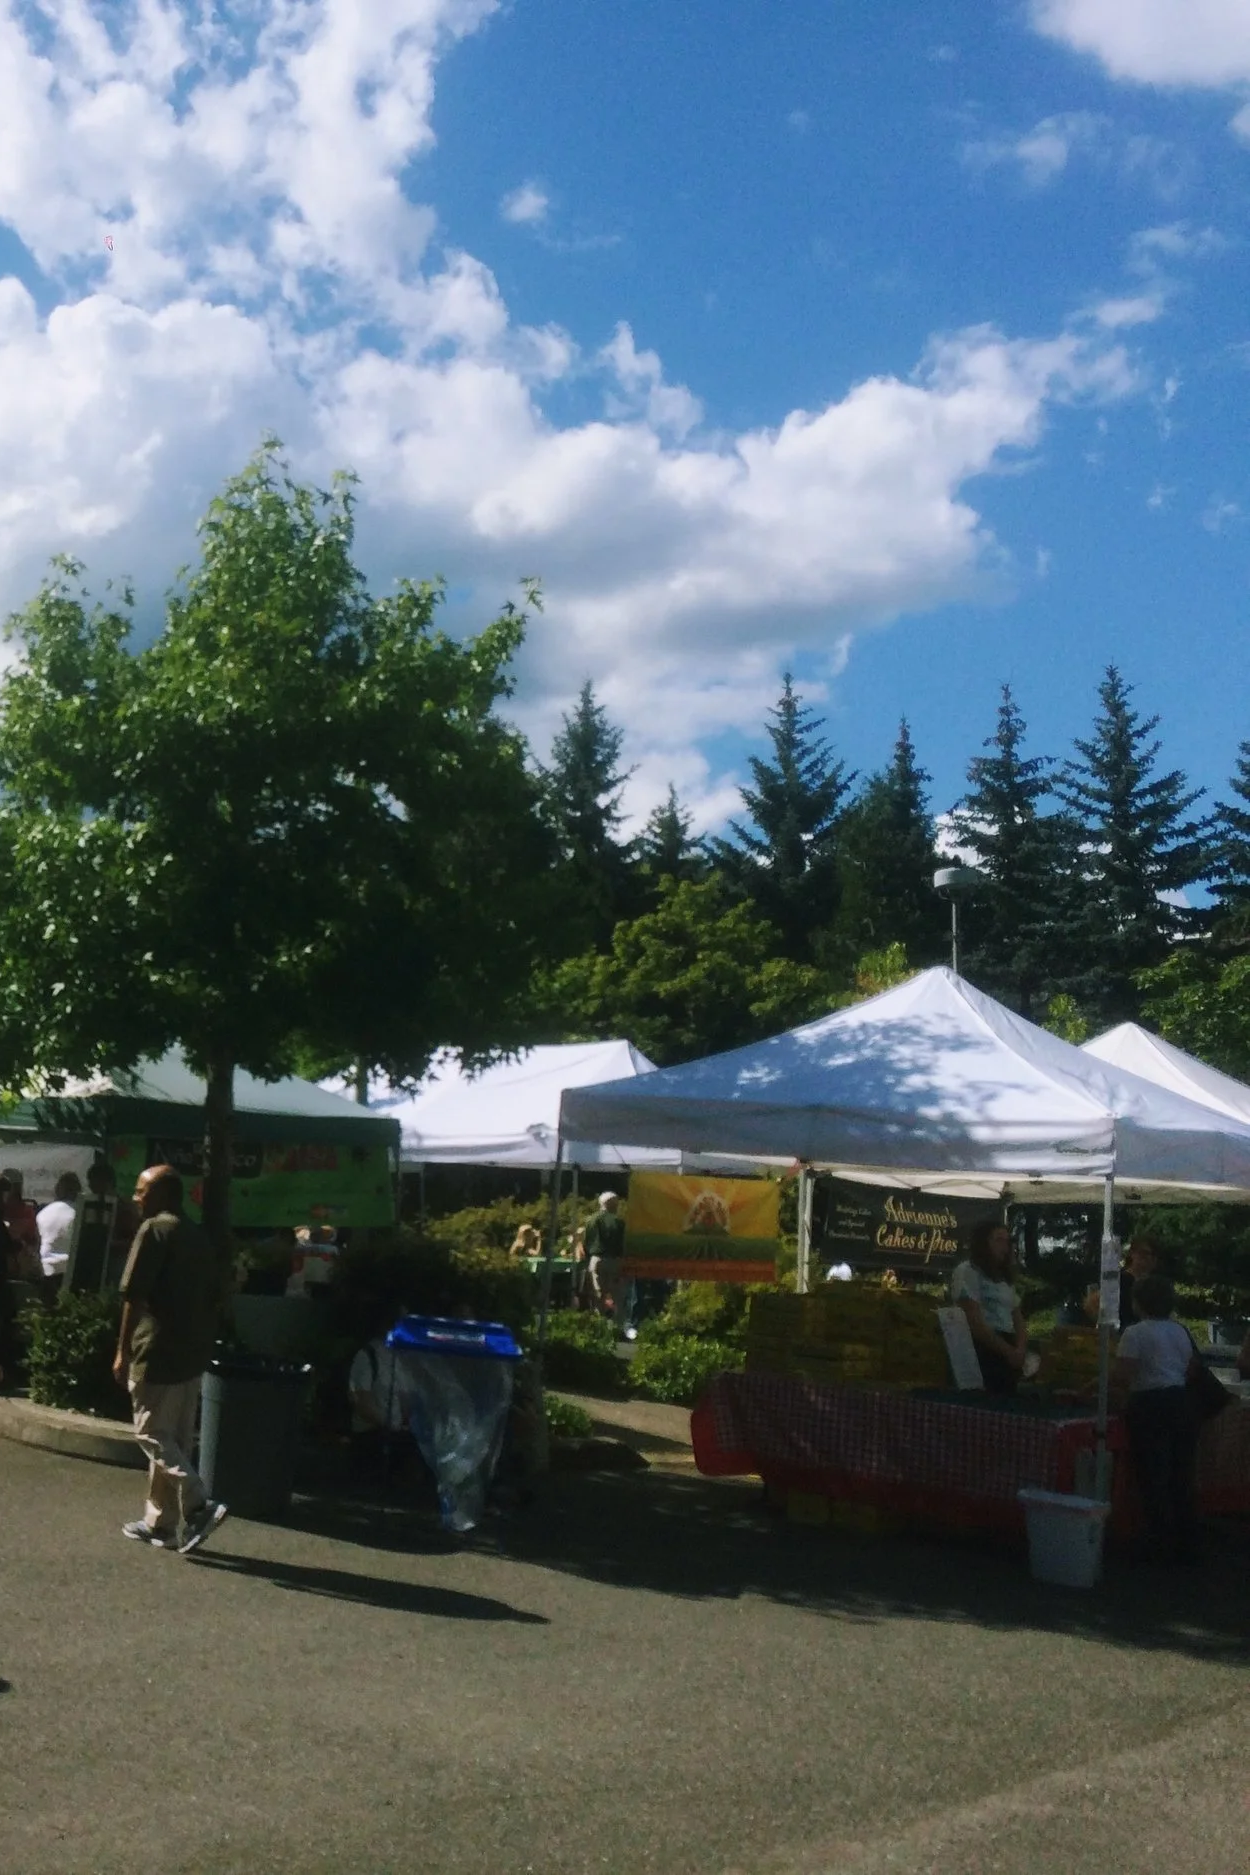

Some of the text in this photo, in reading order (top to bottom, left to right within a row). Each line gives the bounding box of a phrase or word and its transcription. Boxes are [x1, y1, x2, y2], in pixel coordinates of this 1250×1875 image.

[884, 1196, 958, 1229] Adrienne's
[876, 1224, 918, 1249] Cakes
[918, 1231, 929, 1250] &
[924, 1229, 959, 1264] Pies
